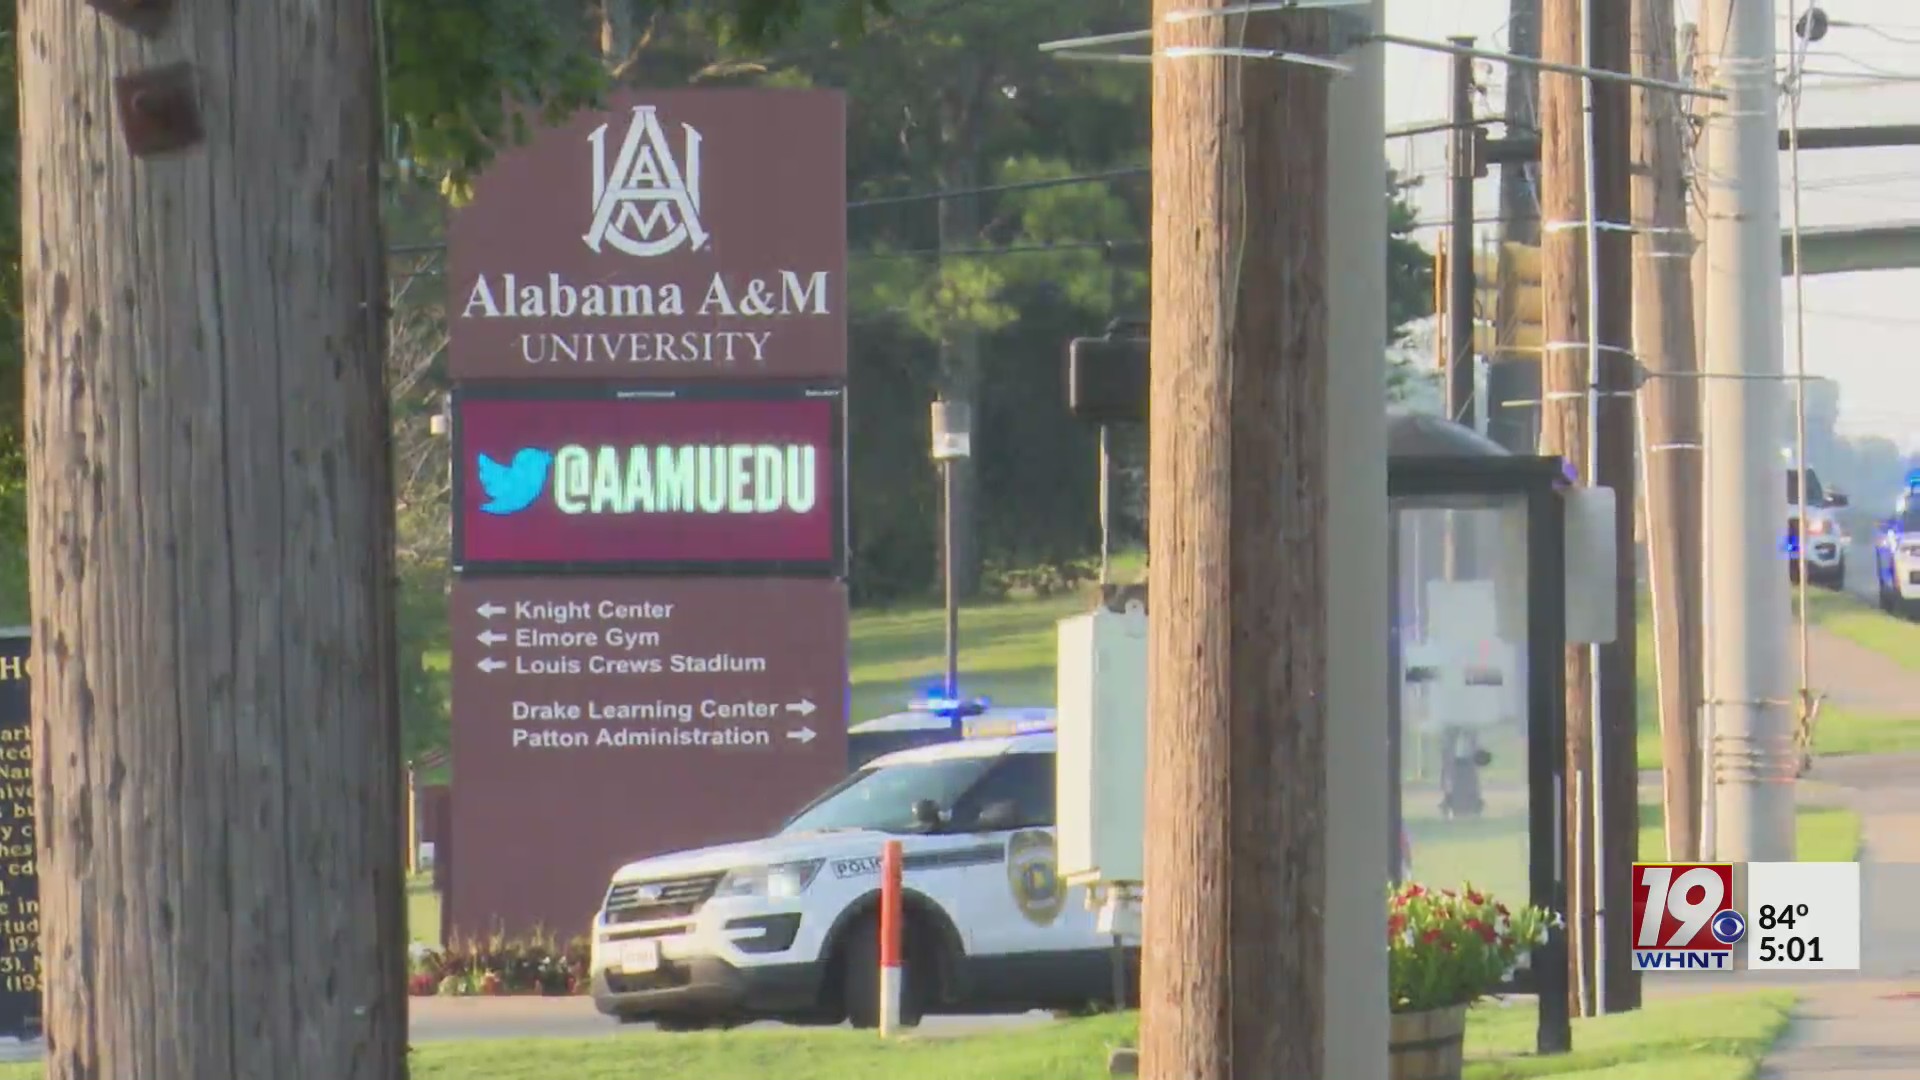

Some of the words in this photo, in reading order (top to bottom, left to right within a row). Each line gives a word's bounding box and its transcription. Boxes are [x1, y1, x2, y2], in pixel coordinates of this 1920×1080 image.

[461, 272, 684, 318] Alabama
[697, 269, 831, 317] A&M
[520, 331, 772, 364] UNIVERSITY
[554, 444, 816, 515] @AAMUEDU
[515, 601, 591, 623] Knight
[598, 600, 674, 620] Center
[515, 629, 598, 648] Elmore
[605, 628, 660, 651] Gym
[0, 656, 31, 681] H
[515, 656, 581, 675] Louis
[588, 656, 662, 674] Crews
[670, 653, 766, 673] Stadium
[512, 701, 581, 720] Drake
[588, 700, 693, 722] Learning
[700, 698, 779, 717] Center
[512, 728, 589, 747] Patton
[596, 726, 770, 746] Administration
